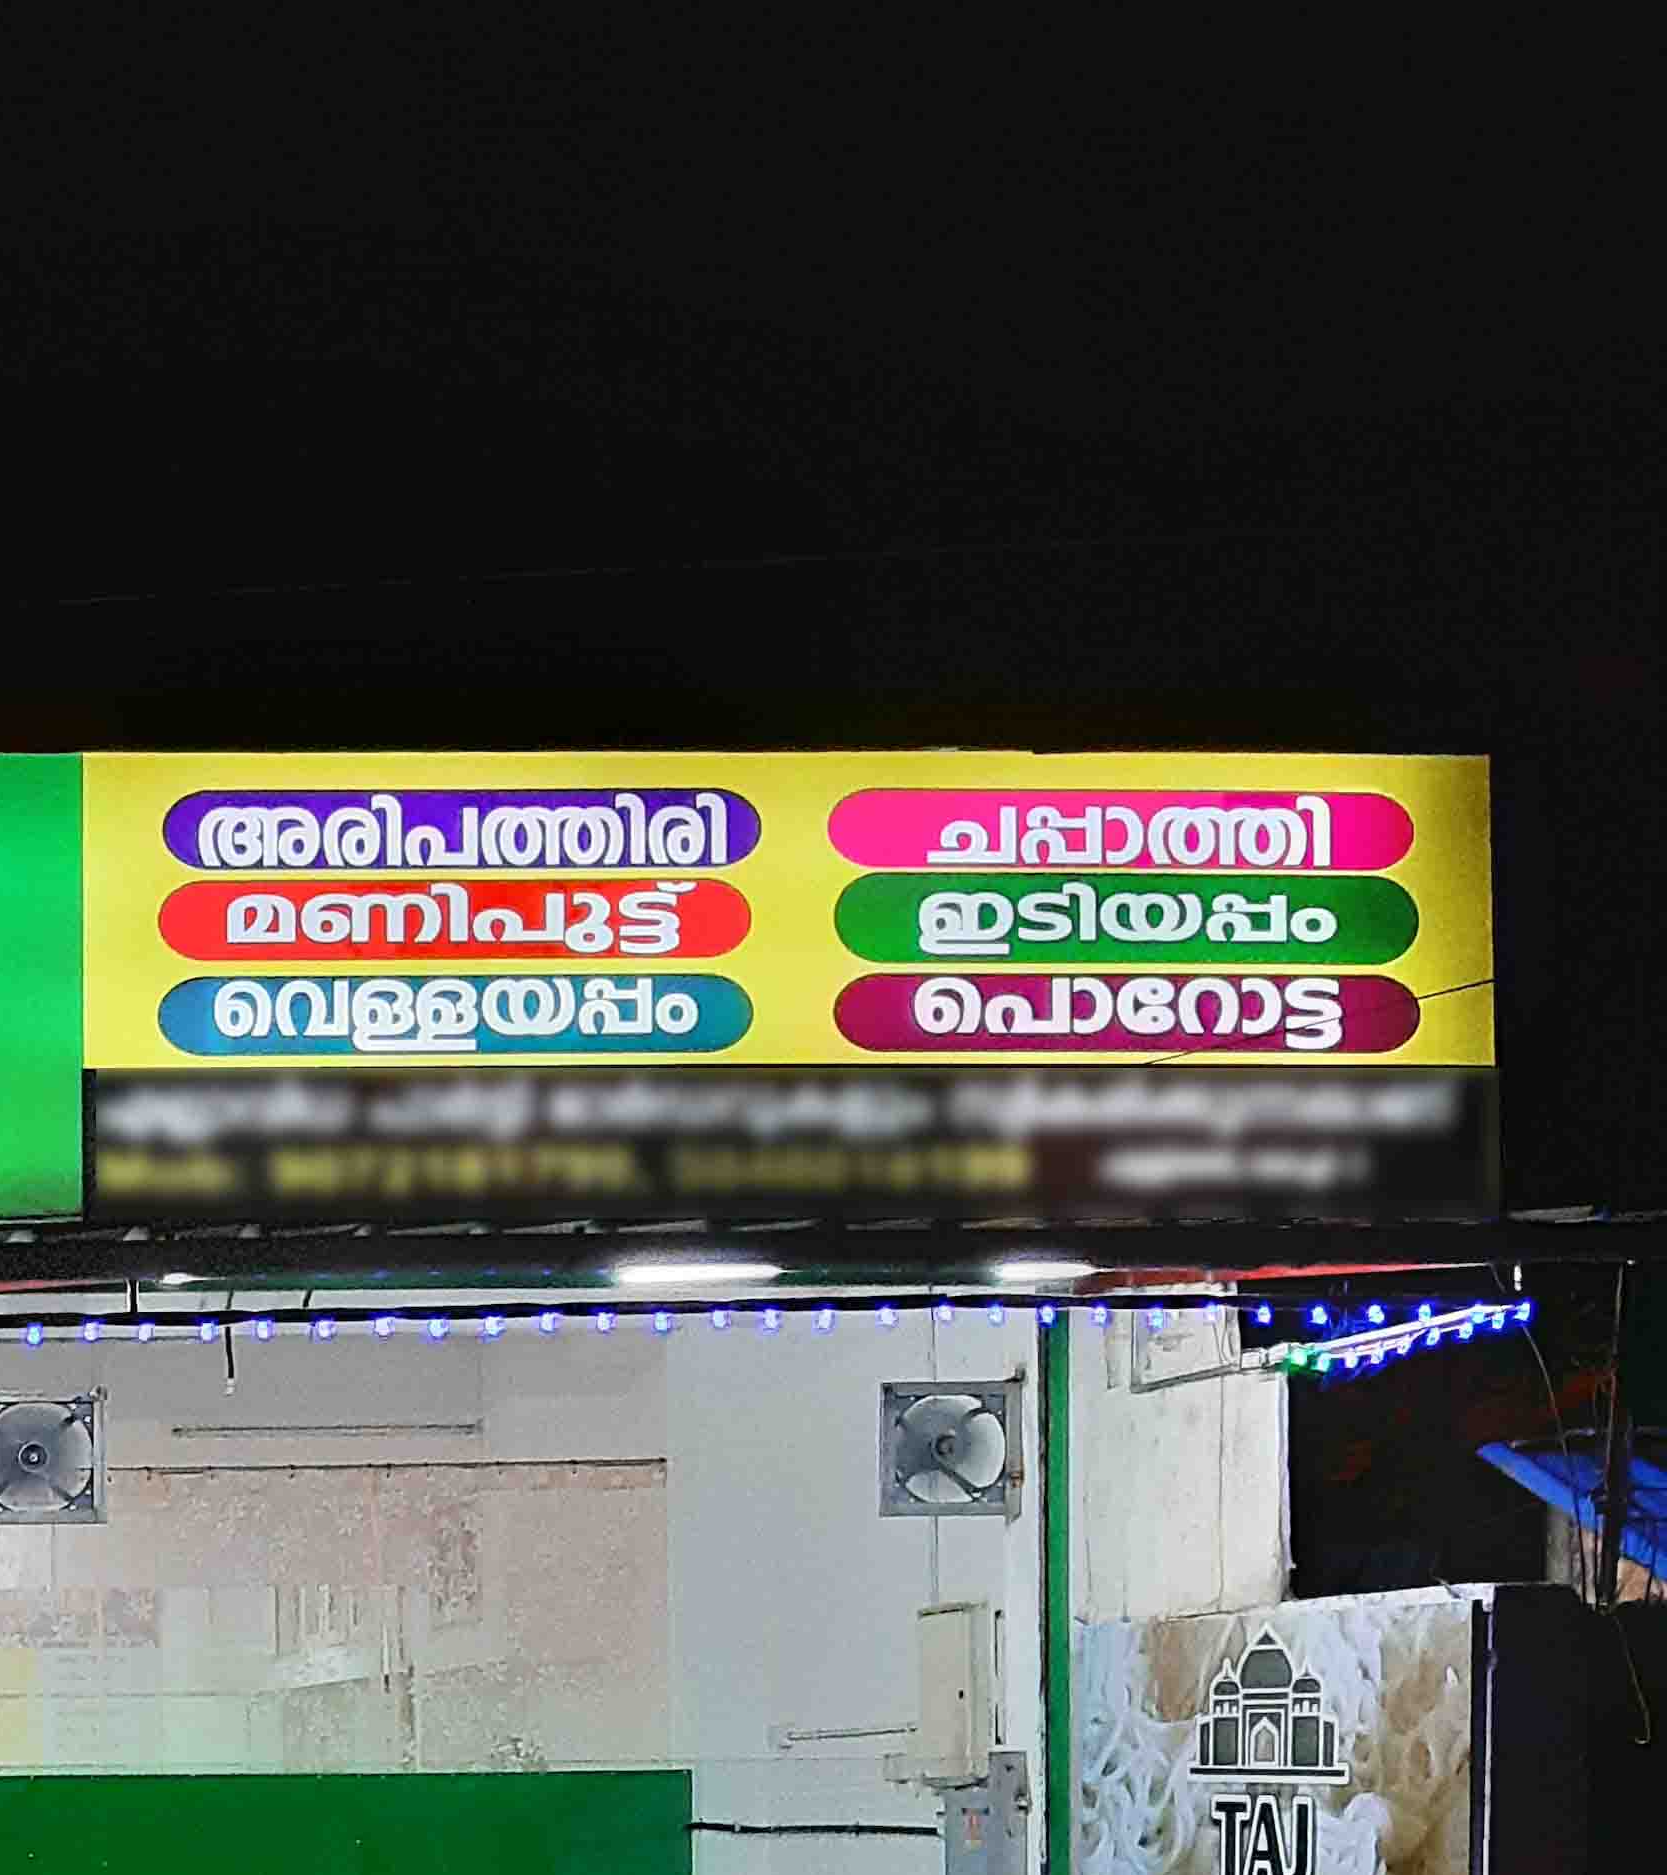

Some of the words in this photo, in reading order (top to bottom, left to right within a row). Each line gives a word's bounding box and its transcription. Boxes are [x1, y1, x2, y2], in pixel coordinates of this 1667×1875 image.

[198, 792, 728, 867] അരിപത്തിരി
[926, 795, 1331, 867] ചപ്പാത്തി
[226, 881, 698, 954] മണിപുട്ട്
[917, 882, 1338, 956] ഇടിയപ്പം
[213, 977, 699, 1052] വെള്ളയപ്പം
[912, 976, 1344, 1050] പൊറോട്ട
